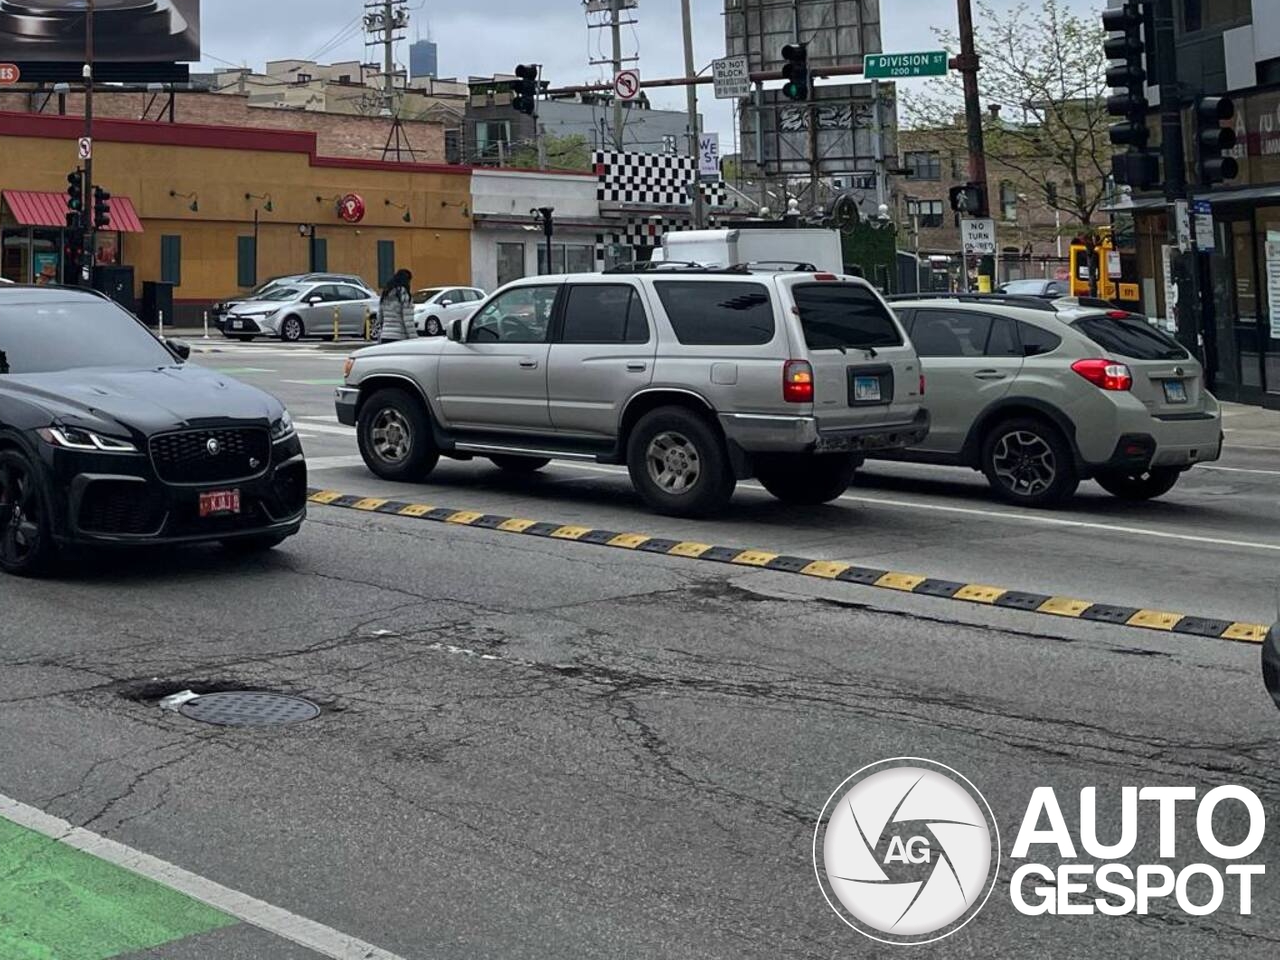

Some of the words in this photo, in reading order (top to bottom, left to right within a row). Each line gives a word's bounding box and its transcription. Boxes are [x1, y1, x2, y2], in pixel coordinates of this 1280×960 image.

[715, 62, 726, 70] DO
[729, 60, 745, 68] NOT
[879, 55, 929, 68] DIVISION
[718, 70, 743, 78] BLOCK
[890, 67, 910, 75] 1200
[971, 222, 984, 230] NO
[968, 232, 989, 240] TURN
